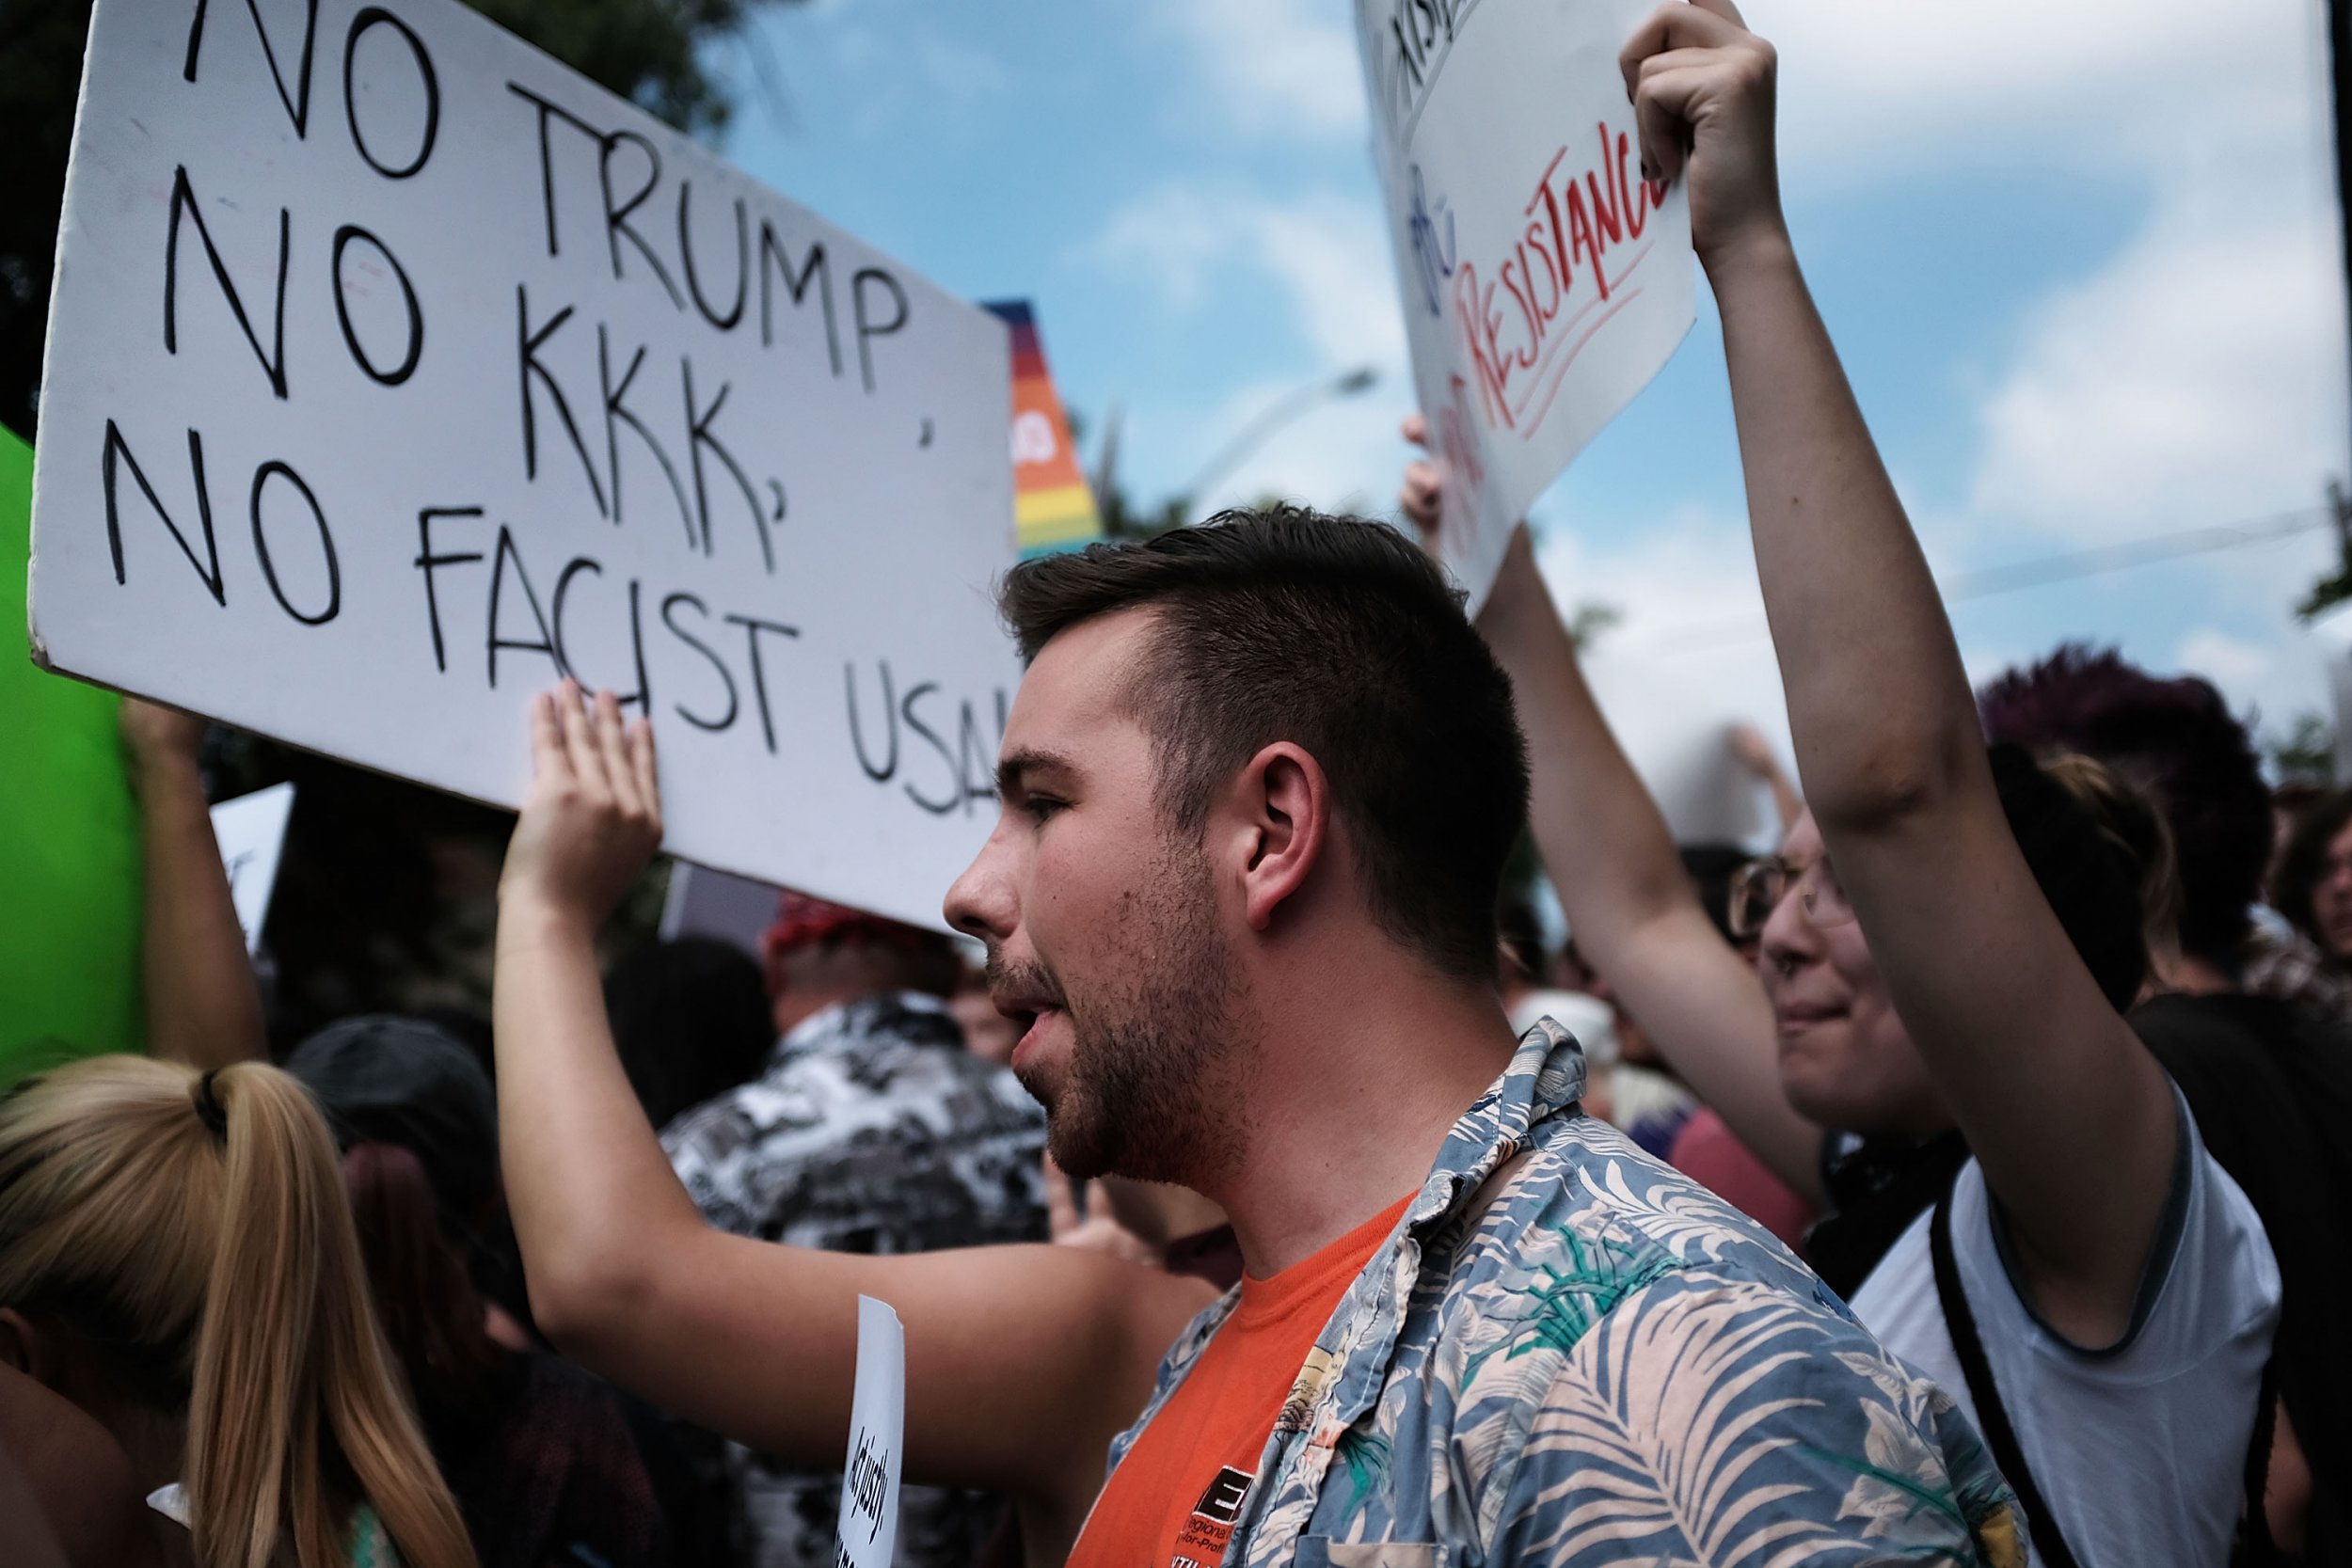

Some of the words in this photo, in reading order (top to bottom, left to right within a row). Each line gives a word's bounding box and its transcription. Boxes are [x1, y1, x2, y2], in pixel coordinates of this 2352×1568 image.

[183, 0, 441, 180] NO
[164, 164, 424, 401] NO
[1454, 120, 1671, 431] RESISTANC
[102, 418, 341, 626] NO
[414, 505, 801, 756] FACIST
